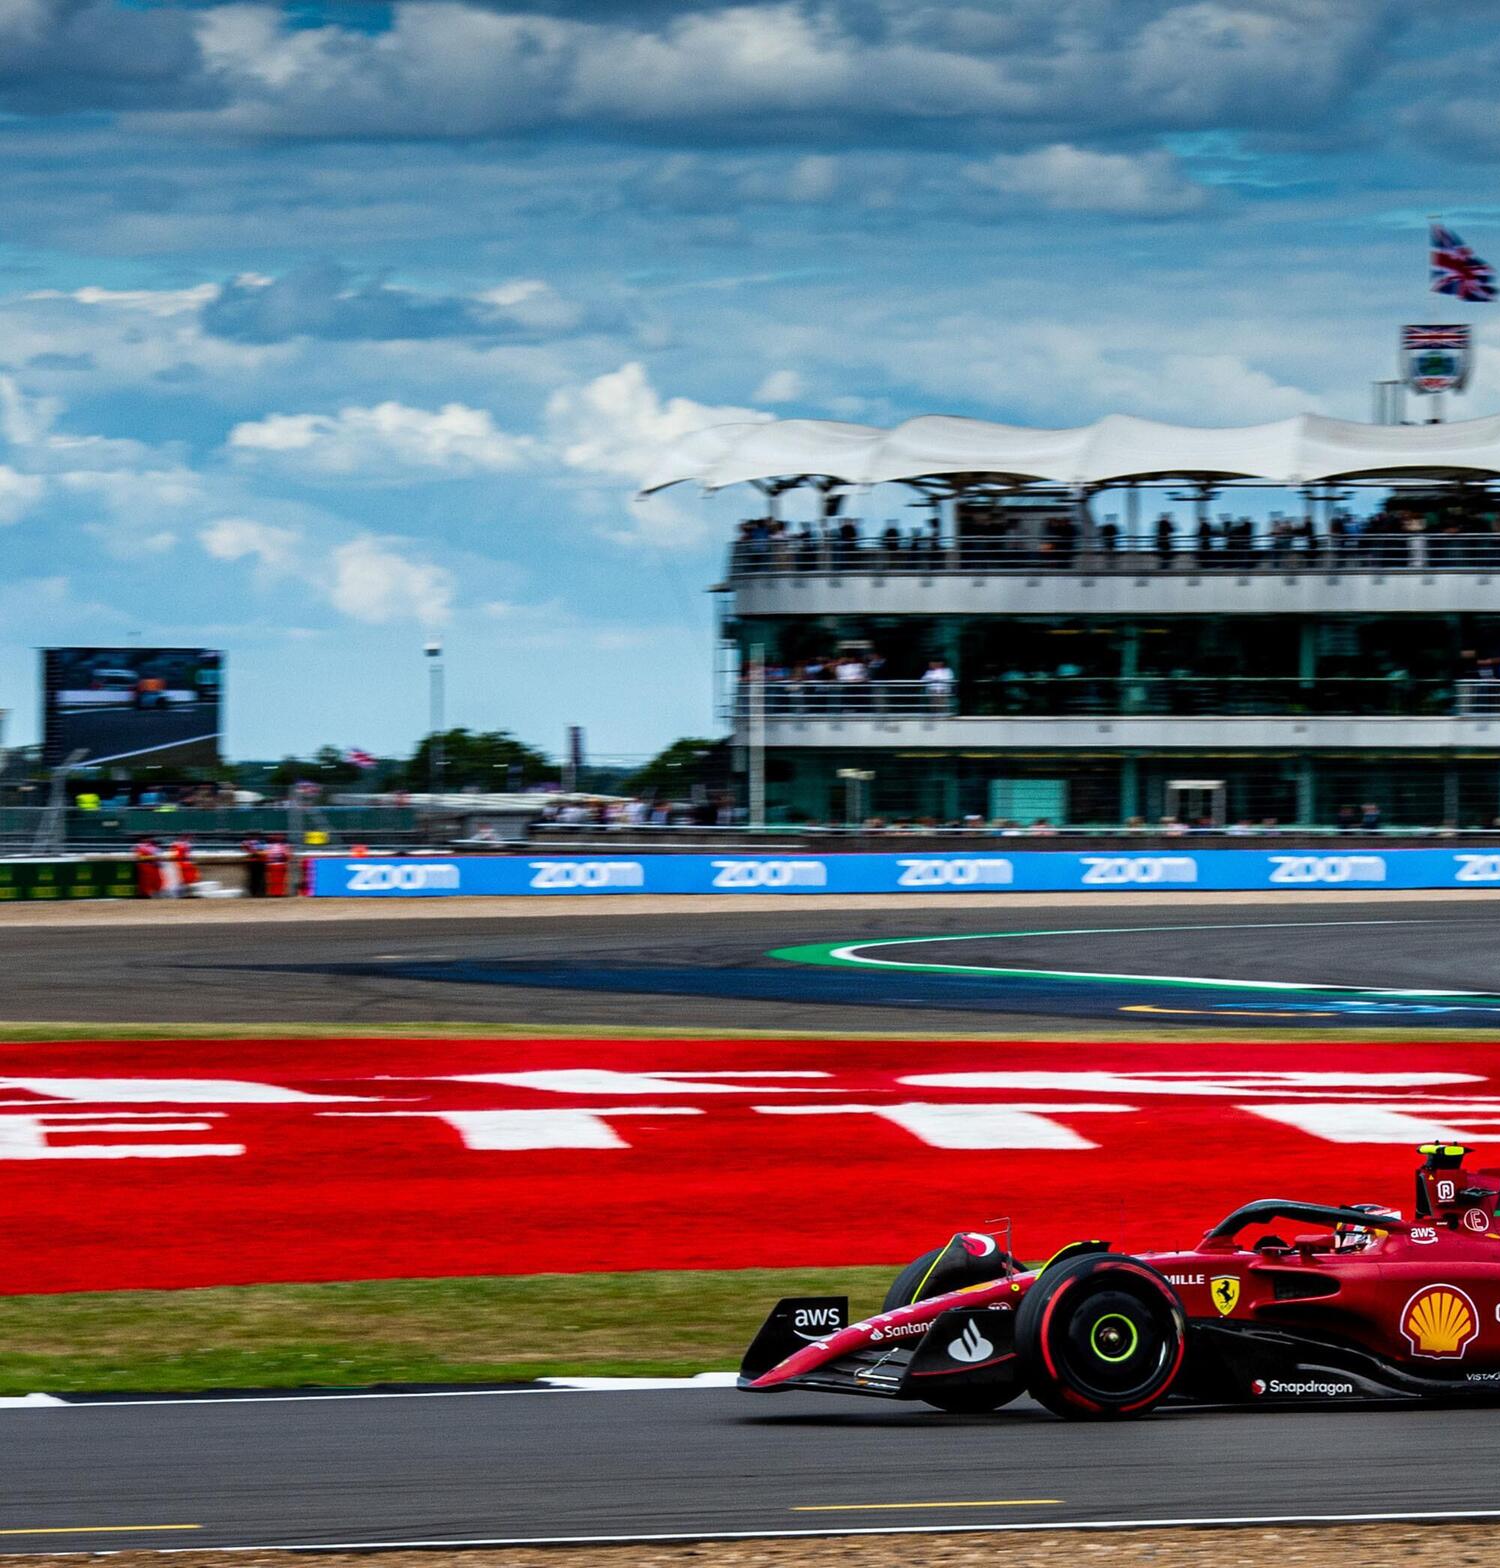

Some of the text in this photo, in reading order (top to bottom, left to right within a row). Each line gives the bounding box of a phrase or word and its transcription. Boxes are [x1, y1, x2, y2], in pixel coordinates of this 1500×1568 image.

[348, 864, 459, 890] zoom
[530, 862, 643, 888] zoom
[712, 861, 826, 887] zoom
[898, 859, 1013, 885] zoom
[1082, 858, 1197, 883] zoom
[1269, 856, 1386, 882] zoom
[1410, 1227, 1437, 1239] aws
[1163, 1274, 1205, 1285] MILLE
[794, 1307, 841, 1327] aws
[1269, 1379, 1353, 1396] Snapdragon
